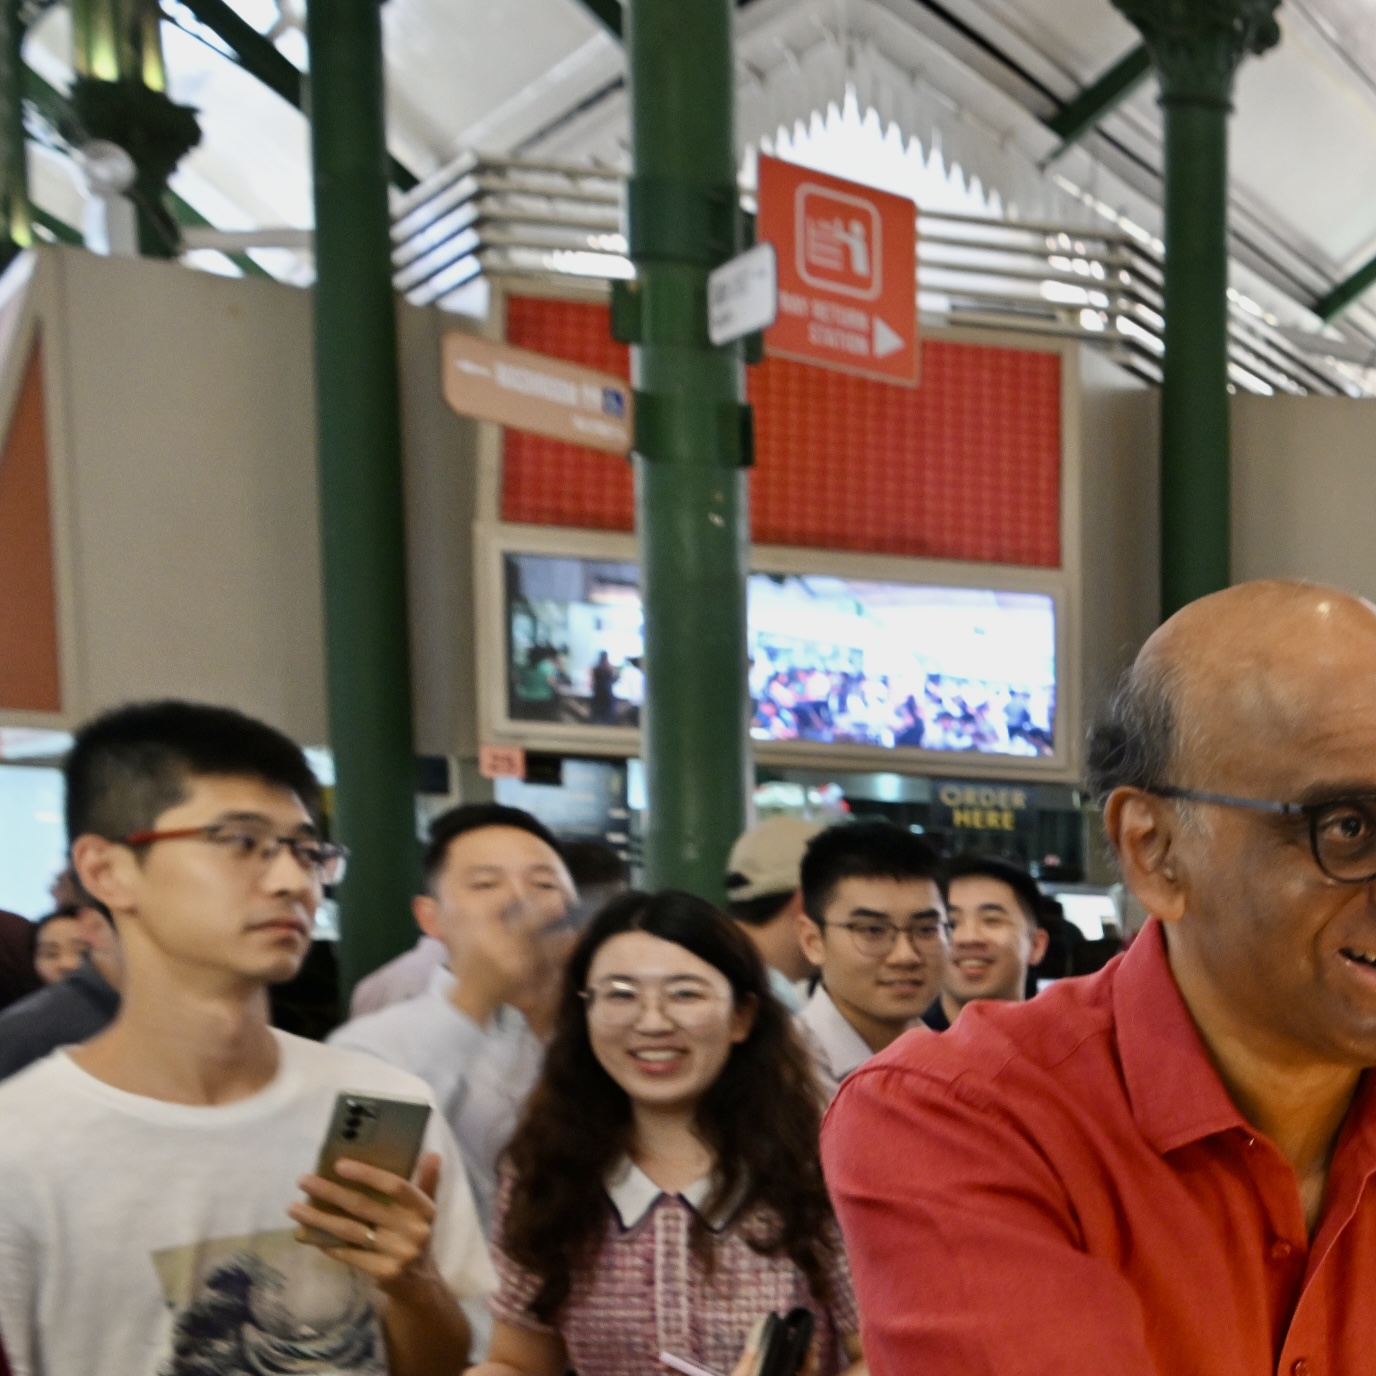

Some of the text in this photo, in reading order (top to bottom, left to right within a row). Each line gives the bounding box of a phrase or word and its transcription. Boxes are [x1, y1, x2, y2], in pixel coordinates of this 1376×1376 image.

[779, 288, 809, 318] RAY
[807, 320, 870, 356] STATION
[940, 784, 1027, 810] ORDER
[952, 808, 1016, 831] HERE
